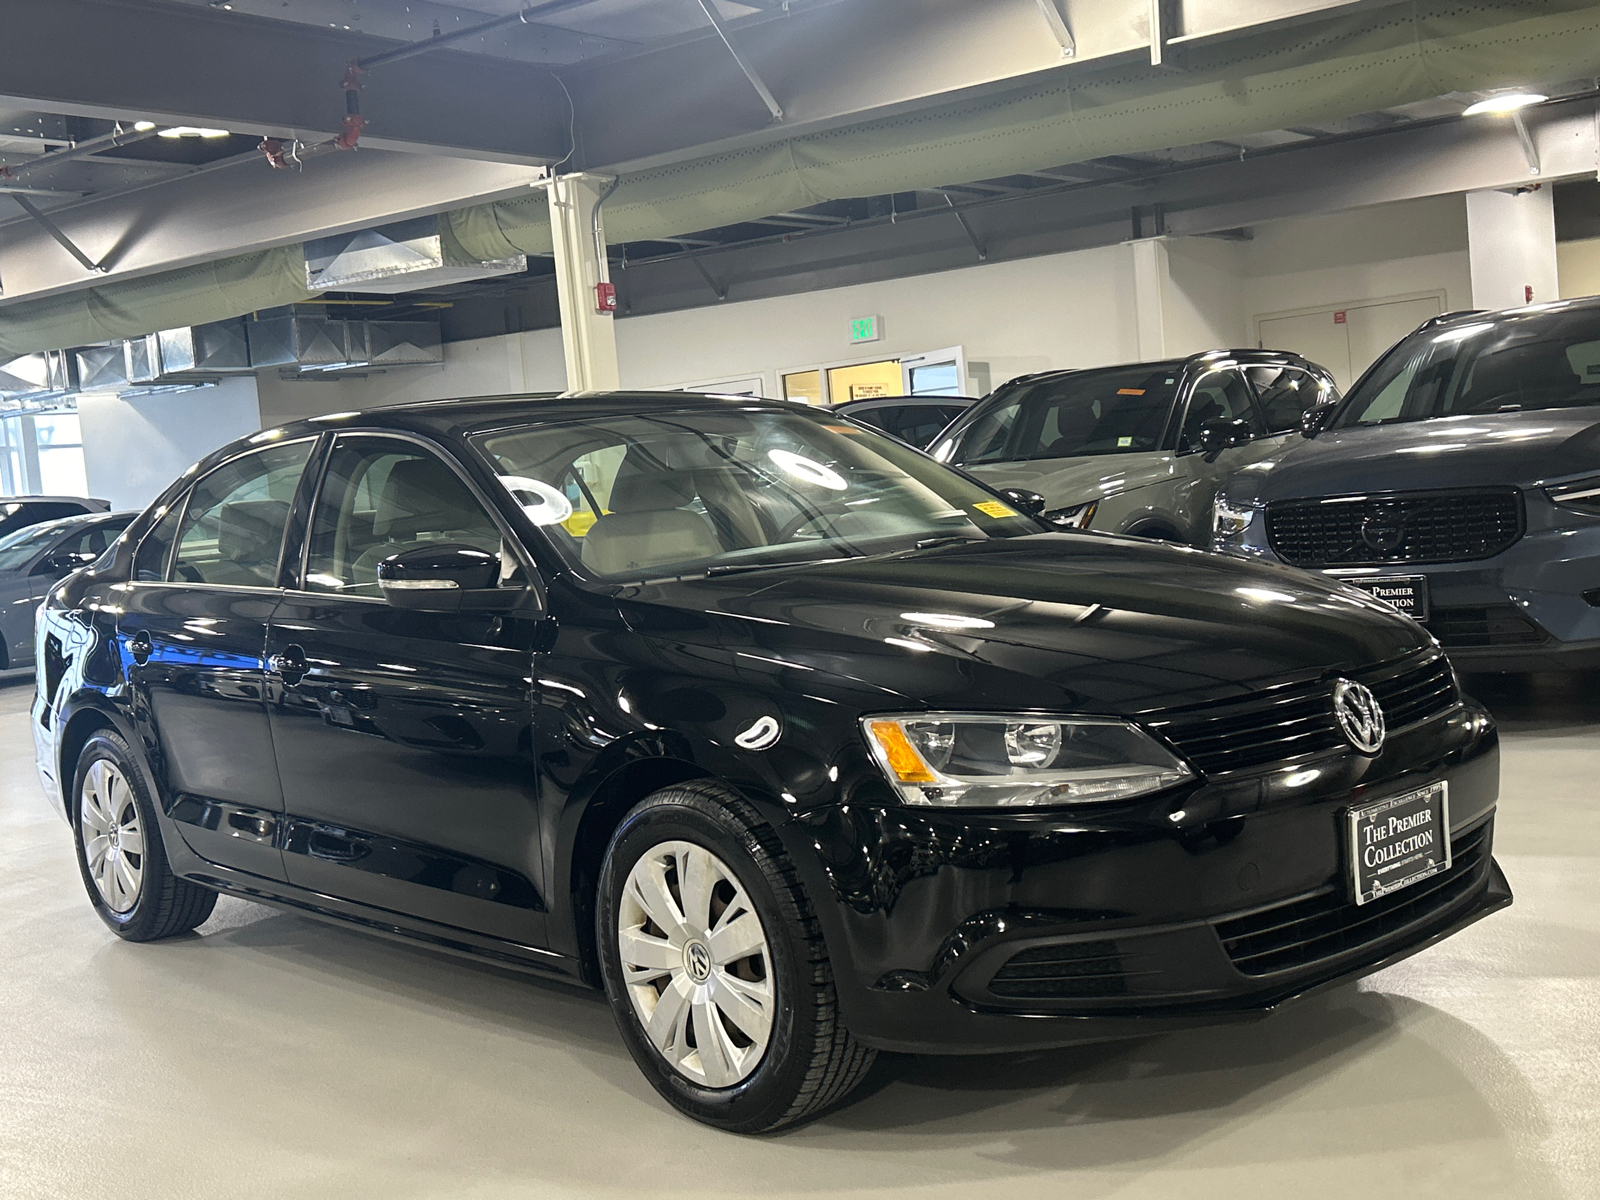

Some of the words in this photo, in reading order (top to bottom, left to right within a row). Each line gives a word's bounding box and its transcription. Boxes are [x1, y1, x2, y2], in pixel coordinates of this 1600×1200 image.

[853, 318, 873, 339] EXIT
[1371, 586, 1413, 597] PREMIER
[1363, 824, 1387, 845] THE
[1387, 809, 1432, 837] PREMIER
[1364, 829, 1433, 868] COLLECTION
